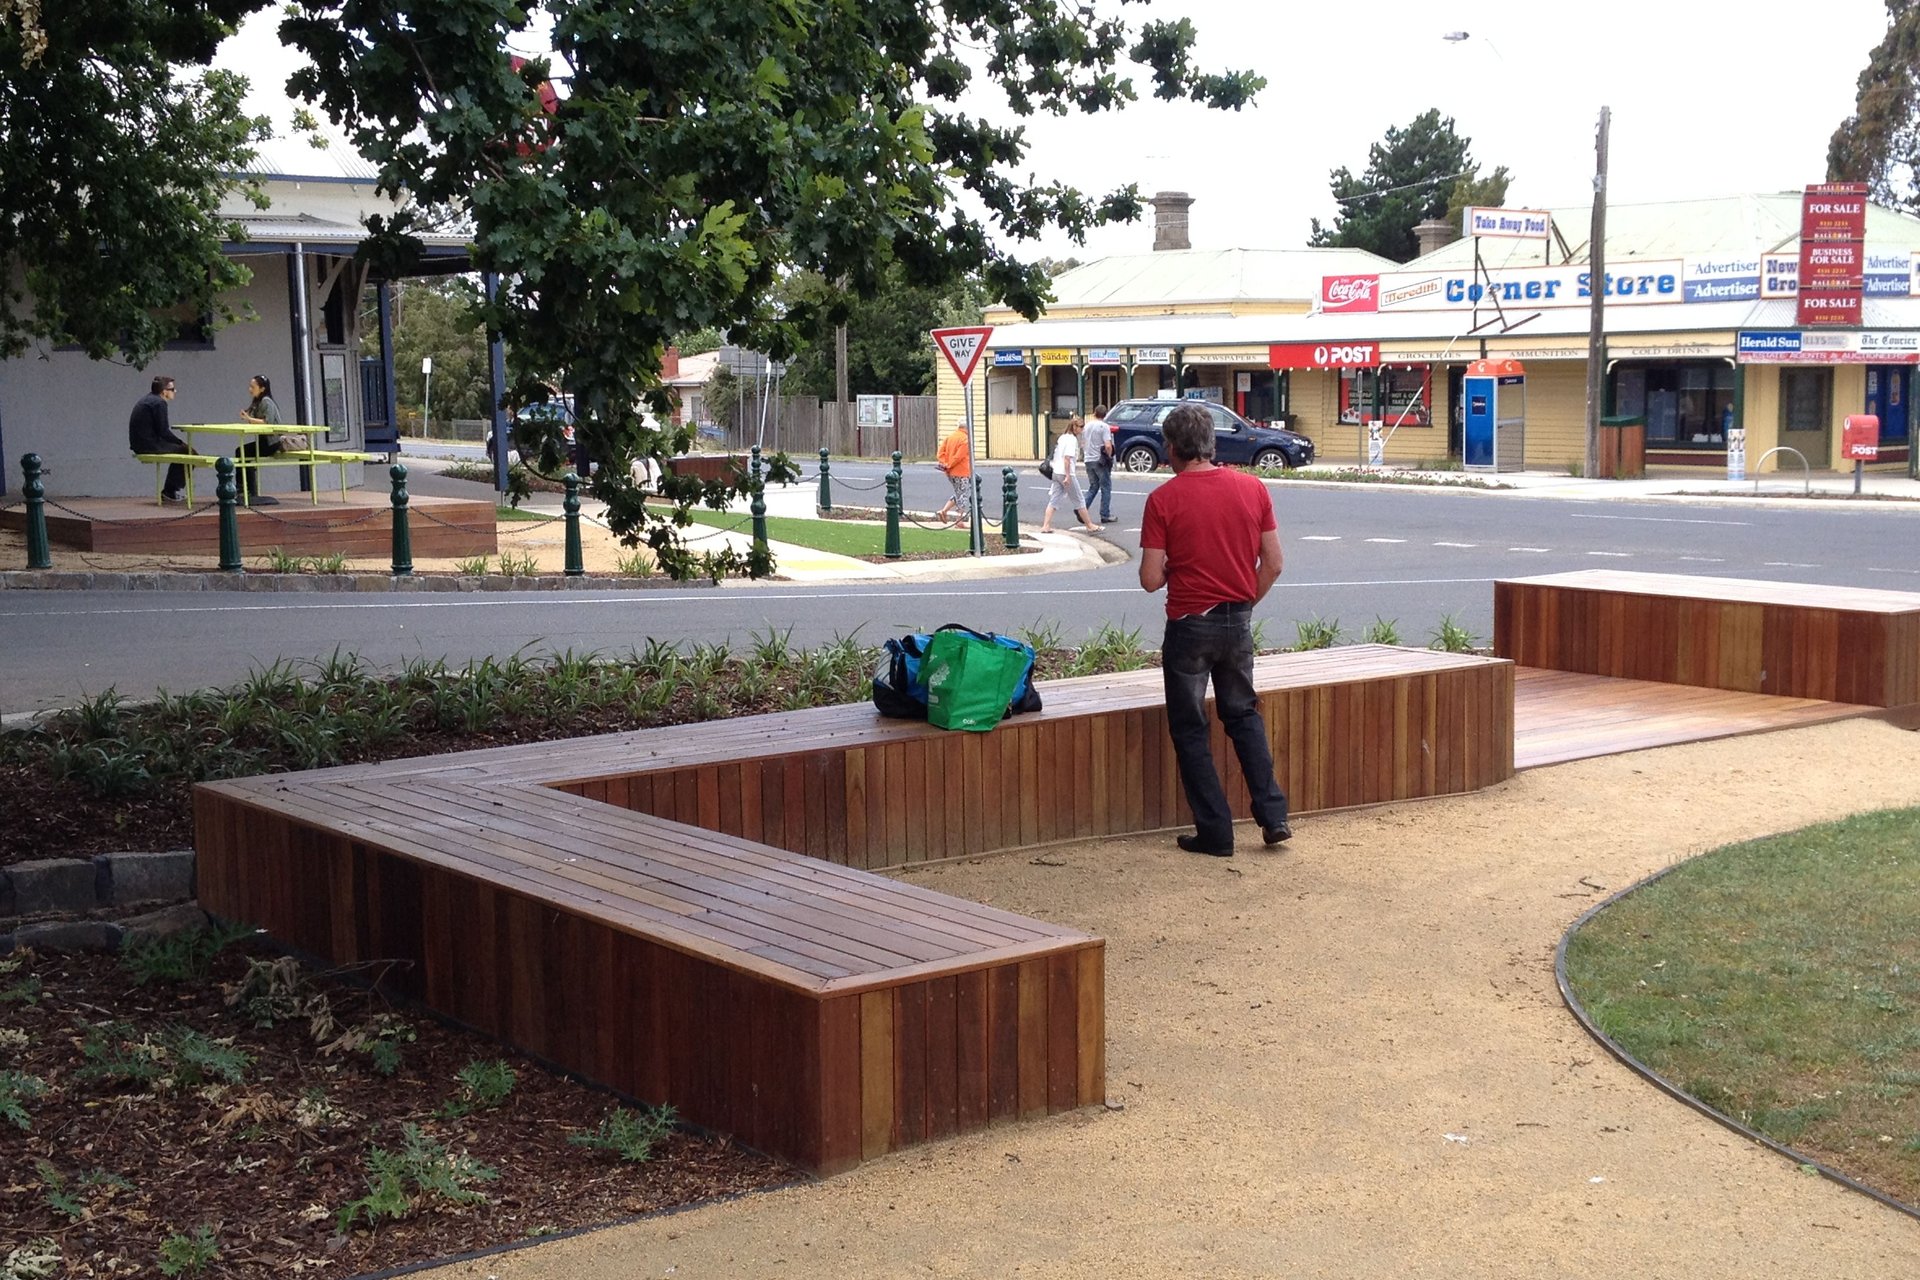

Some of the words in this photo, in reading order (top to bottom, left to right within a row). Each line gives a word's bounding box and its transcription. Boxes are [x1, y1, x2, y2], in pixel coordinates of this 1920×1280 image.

[1809, 204, 1831, 213] FOR
[1833, 204, 1860, 213] SALE
[1475, 216, 1496, 229] Take
[1499, 217, 1523, 233] Away
[1525, 218, 1545, 232] Food
[1812, 248, 1853, 256] BUSINESS
[1809, 255, 1830, 264] FOR
[1831, 255, 1854, 264] SALE
[1867, 255, 1909, 269] Advertiser
[1695, 259, 1759, 275] Advertiser
[1446, 278, 1561, 302] Corner
[1577, 272, 1675, 299] Store
[1694, 281, 1760, 297] Advertiser
[1866, 277, 1909, 292] Advertiser
[1385, 281, 1438, 303] Meredith
[1804, 299, 1827, 308] FOR
[1829, 299, 1856, 308] SALE
[949, 338, 976, 348] GIVE
[1741, 337, 1777, 348] Herald
[1778, 337, 1800, 348] Sun
[1862, 335, 1879, 345] The
[1882, 335, 1917, 345] Courier
[954, 349, 972, 358] WAY
[1331, 346, 1373, 364] POST
[1397, 351, 1462, 360] GROCERIES
[1509, 350, 1579, 358] AMMUNITION
[1632, 348, 1660, 356] COLD
[1667, 347, 1711, 355] DRINKS
[1042, 352, 1069, 363] Sunday
[1200, 354, 1257, 362] NEWSPAPERS
[1851, 446, 1878, 455] POST
